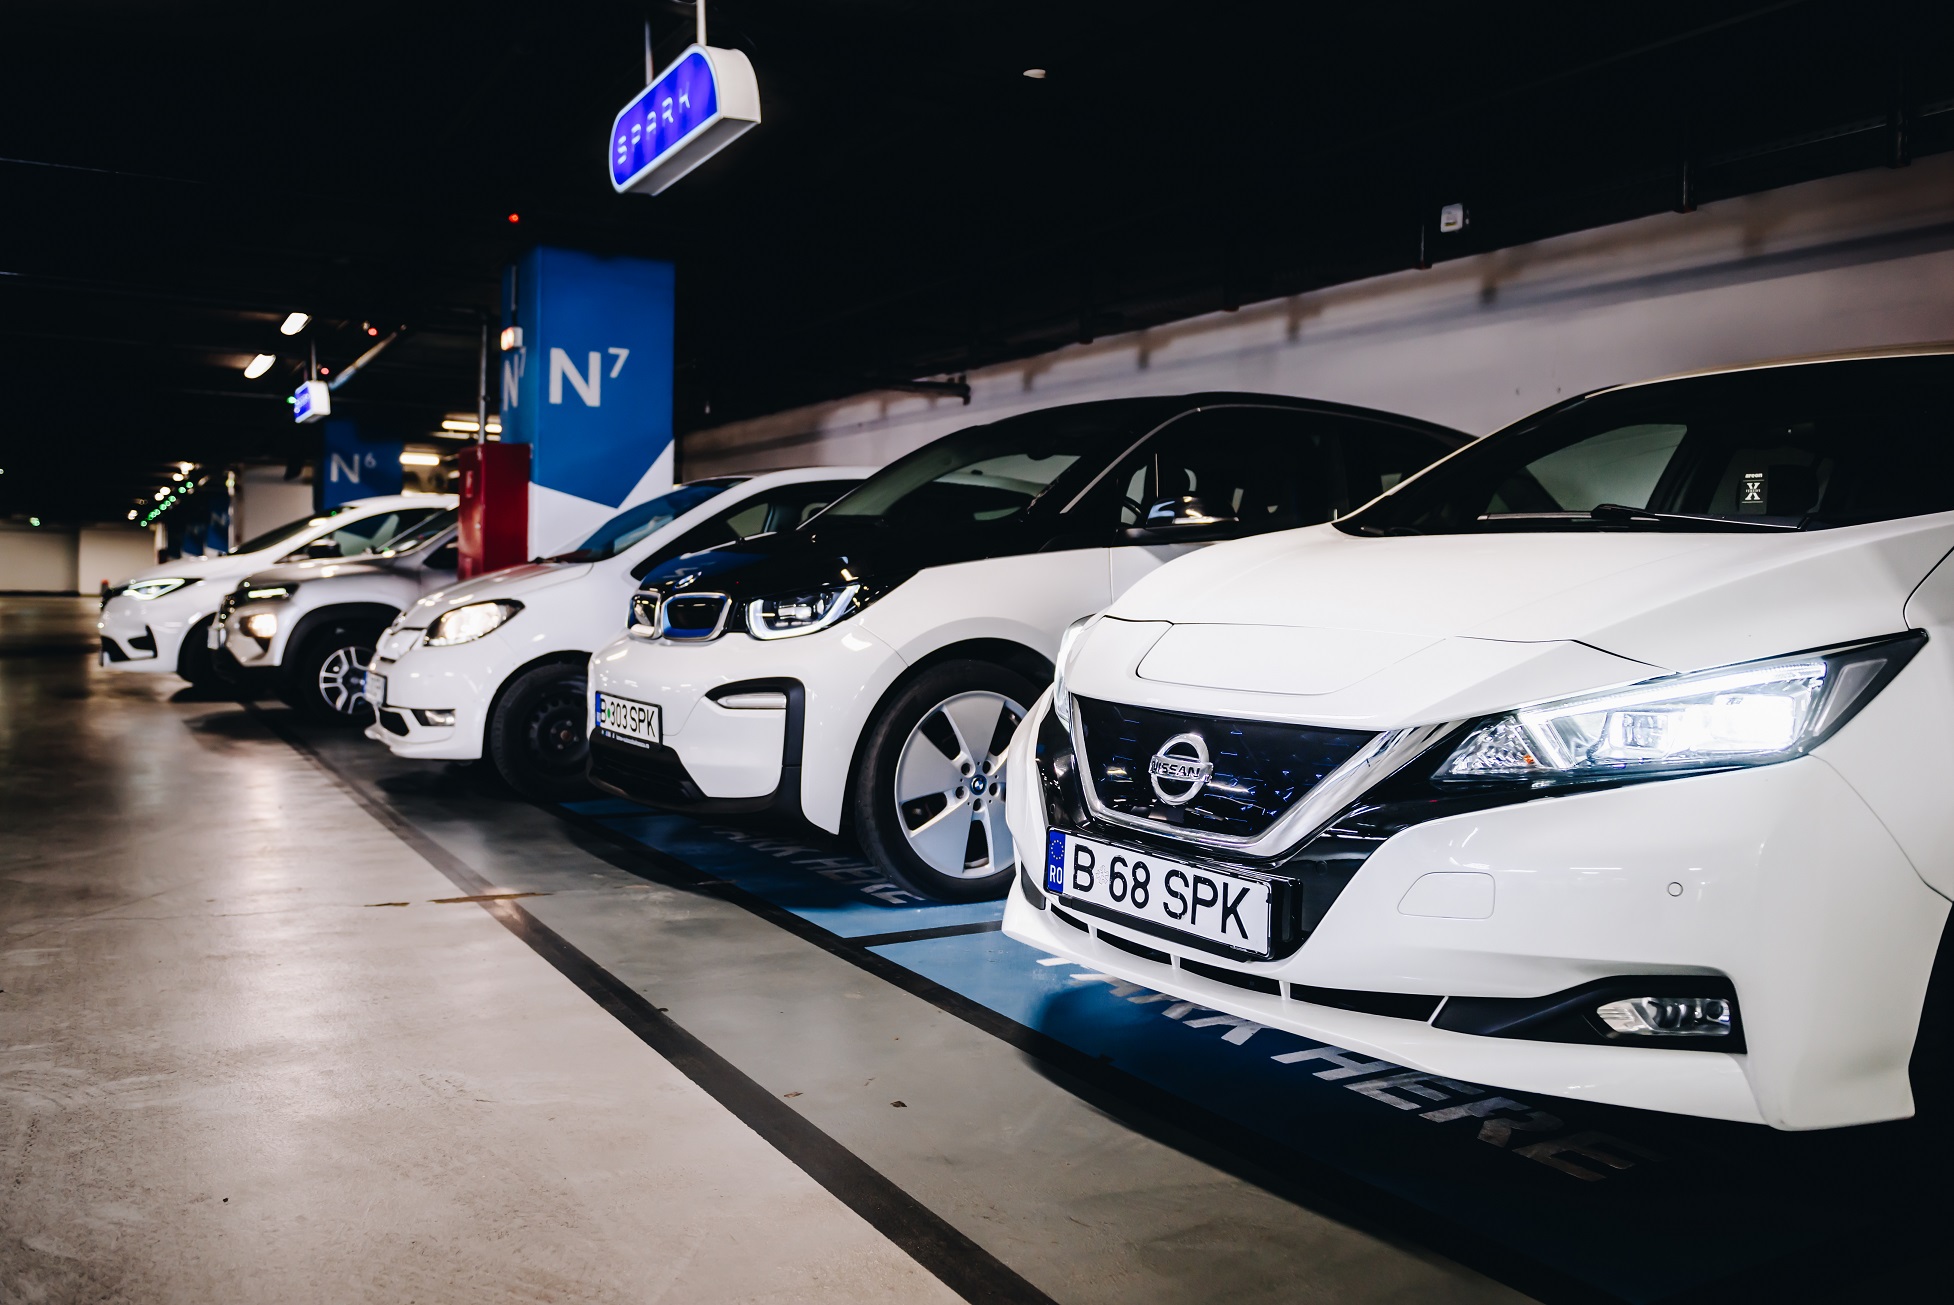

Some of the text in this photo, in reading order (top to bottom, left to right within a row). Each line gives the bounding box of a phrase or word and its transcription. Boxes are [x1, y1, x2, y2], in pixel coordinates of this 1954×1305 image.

[617, 82, 691, 165] SPARK
[549, 347, 630, 407] N7
[600, 698, 656, 738] B 303 SPK
[1150, 760, 1201, 778] NISSAN
[1049, 864, 1063, 886] RO
[1072, 843, 1251, 940] B 68 SPK
[1270, 1046, 1660, 1182] HERE
